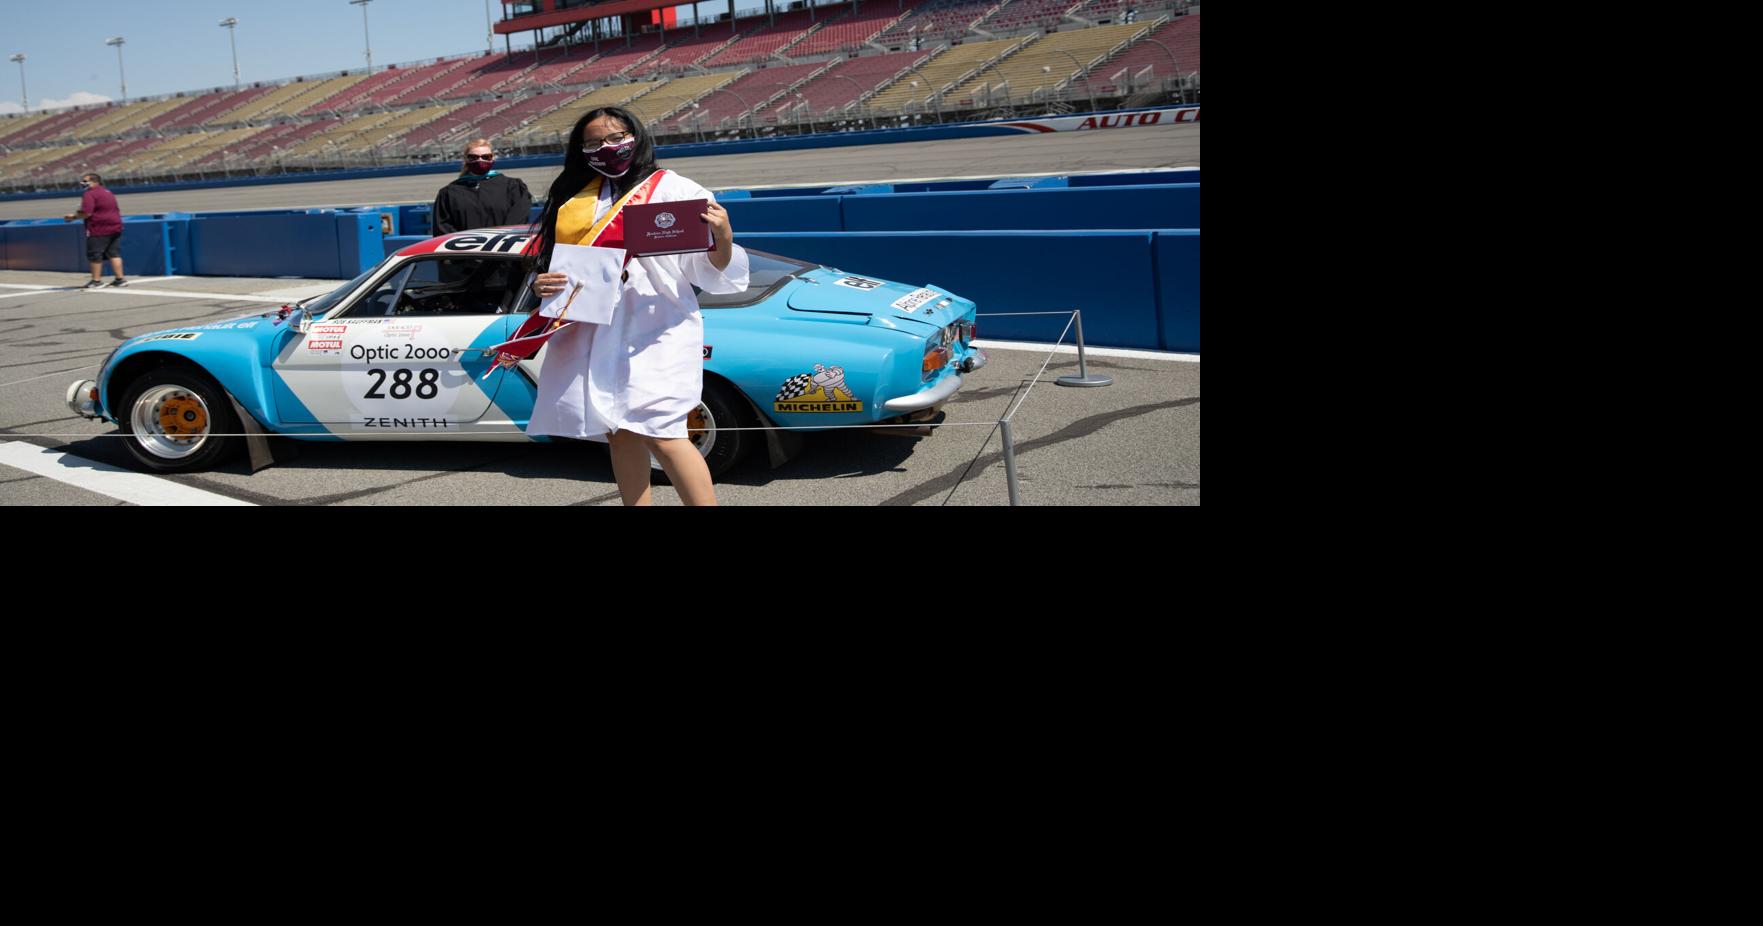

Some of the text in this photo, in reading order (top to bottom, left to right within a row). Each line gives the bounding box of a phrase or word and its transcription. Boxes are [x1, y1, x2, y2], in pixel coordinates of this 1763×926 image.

[1077, 111, 1162, 130] AUTO
[444, 233, 531, 252] elf
[310, 341, 341, 349] MOTUL
[350, 344, 399, 364] Optic
[363, 368, 439, 400] 288
[778, 403, 857, 411] MICHELIN
[363, 417, 447, 428] ZENITH
